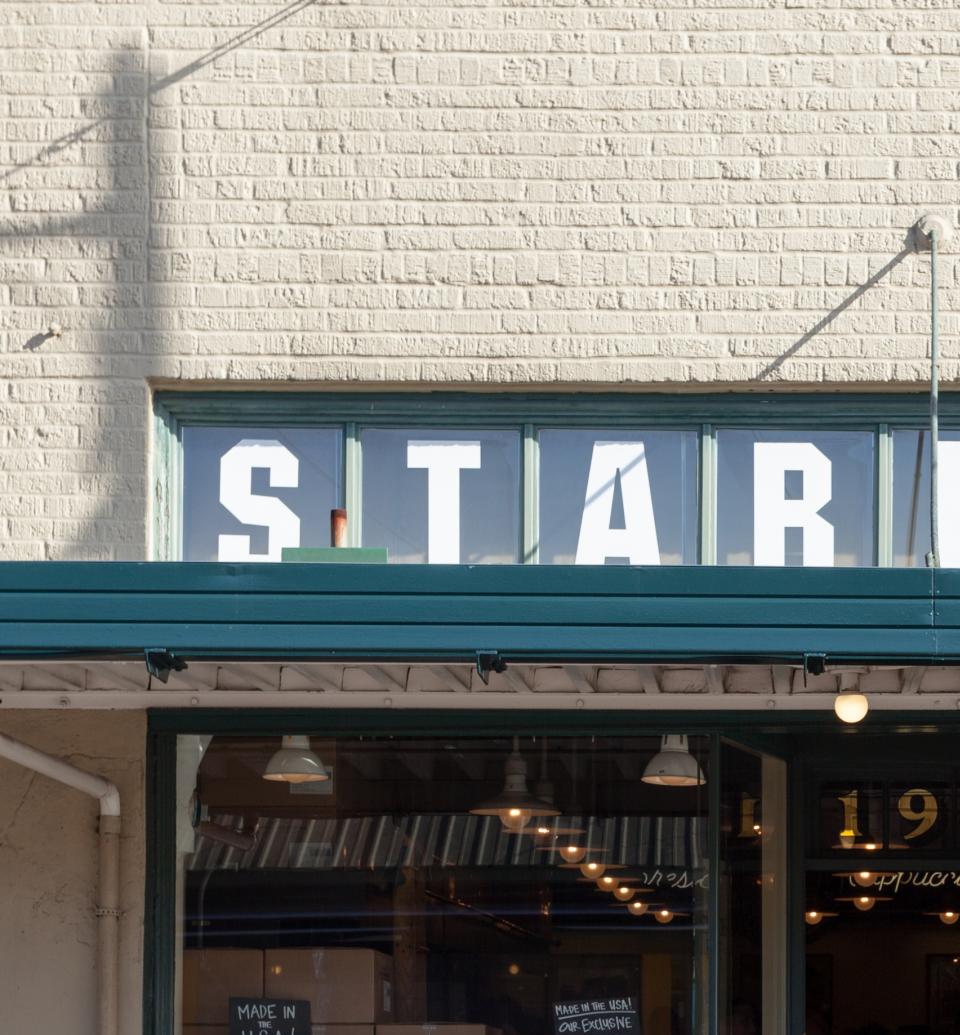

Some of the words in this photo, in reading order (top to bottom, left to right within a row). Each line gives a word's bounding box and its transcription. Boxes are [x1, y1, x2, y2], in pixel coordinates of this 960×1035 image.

[237, 1004, 278, 1020] MADE
[283, 1005, 296, 1020] IN
[555, 1004, 580, 1017] MADE
[581, 1002, 590, 1012] IN
[609, 996, 633, 1011] USA!
[558, 1021, 581, 1033] OUR
